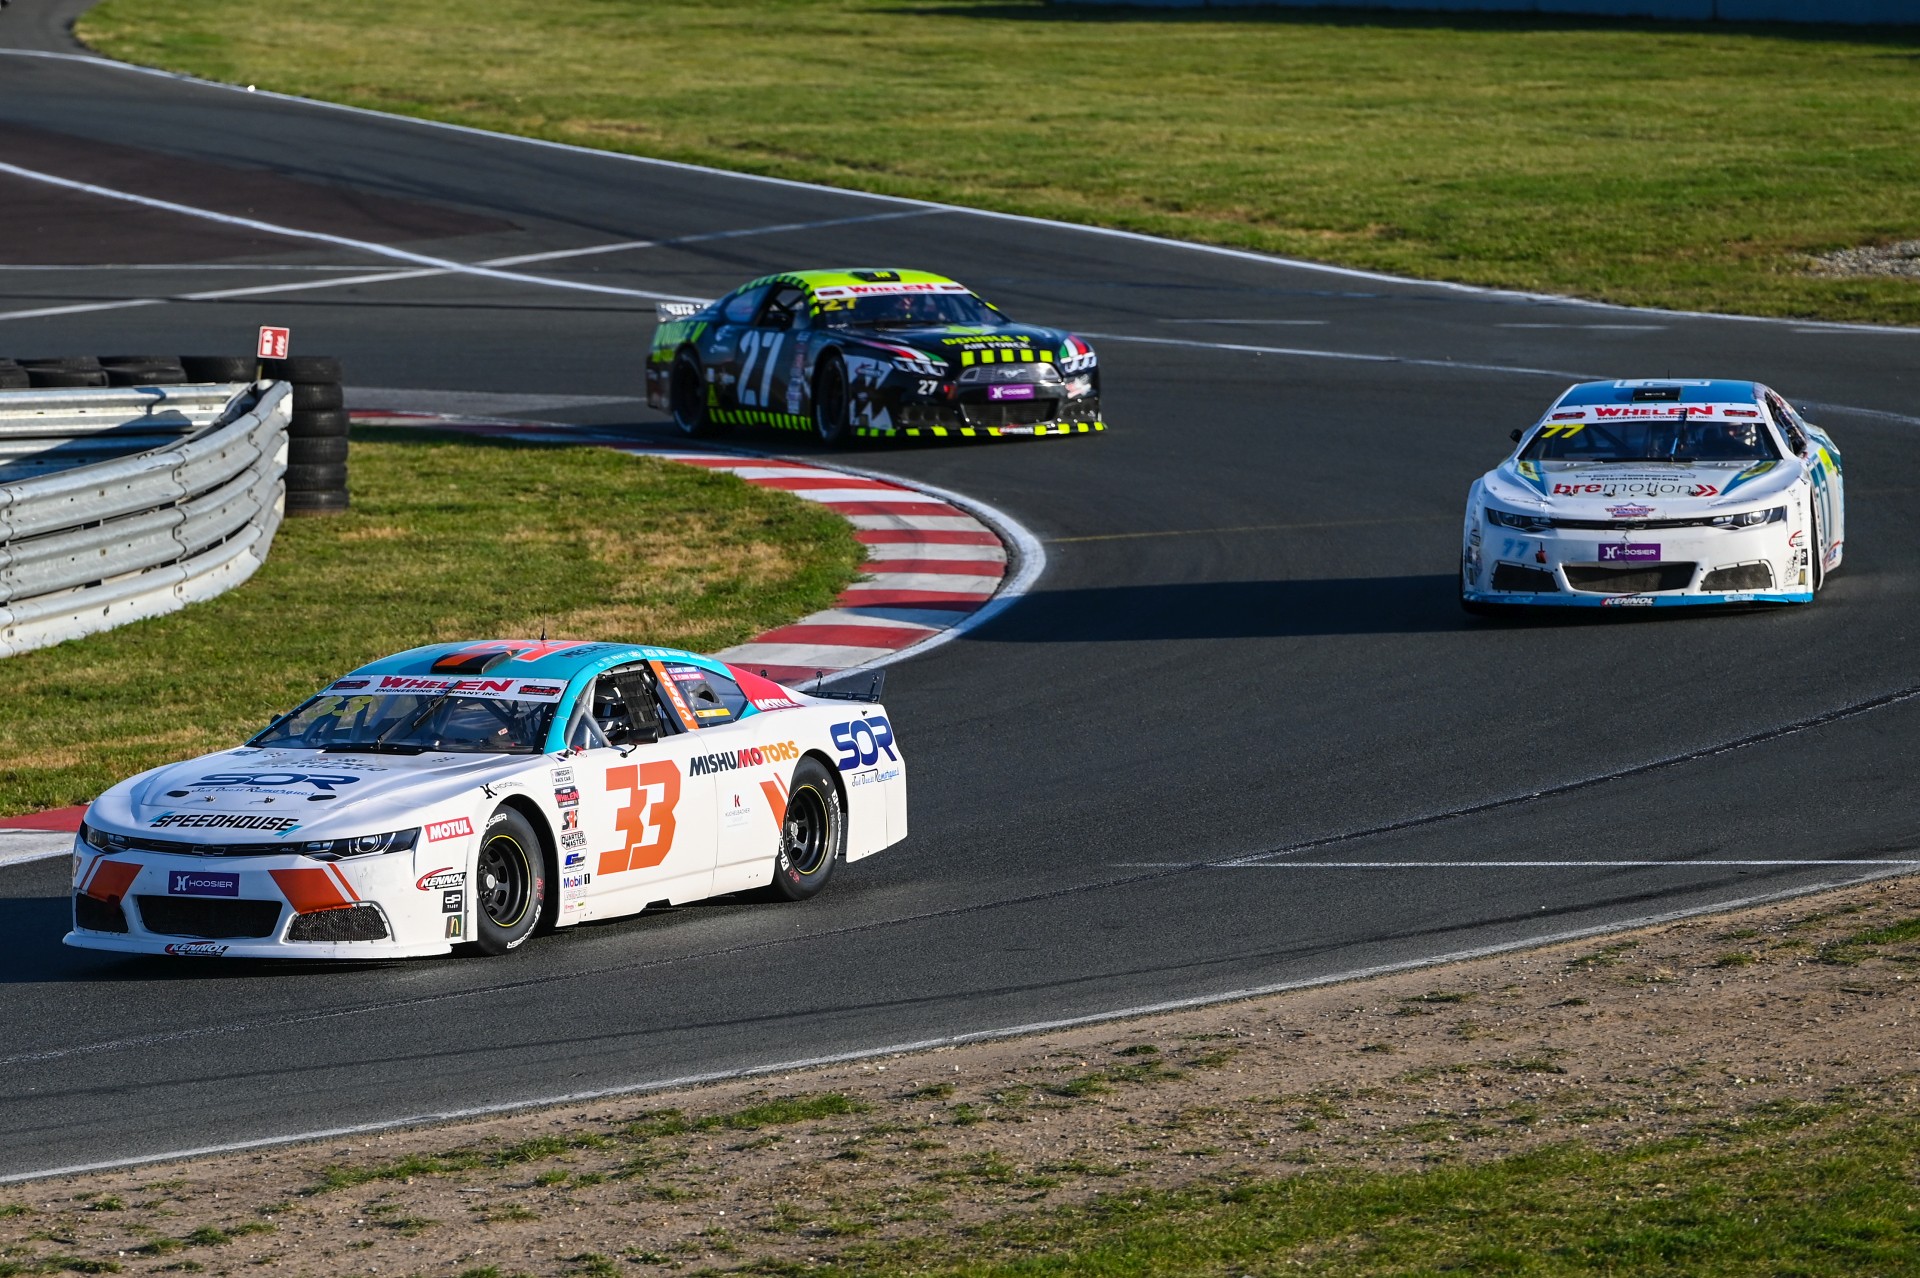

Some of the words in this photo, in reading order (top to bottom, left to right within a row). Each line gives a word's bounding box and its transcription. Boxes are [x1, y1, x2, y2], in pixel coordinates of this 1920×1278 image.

[848, 284, 934, 293] WHELEN
[821, 298, 857, 311] 27
[737, 330, 785, 407] 27
[917, 380, 939, 396] 27
[1595, 406, 1713, 417] WHELEN
[1541, 424, 1585, 438] 77
[1553, 481, 1692, 495] bremotion
[1503, 538, 1531, 559] 77
[379, 676, 515, 692] WHELEN
[755, 698, 793, 711] MOTUL
[830, 716, 897, 771] SOR
[187, 773, 361, 790] SOR
[151, 814, 299, 831] SPEEDHOUSE
[597, 759, 681, 876] 33
[430, 820, 470, 840] MOTUL
[189, 880, 233, 888] HOOSIER
[421, 873, 464, 887] KENNOL
[564, 875, 583, 889] Mobil
[170, 943, 226, 953] KENNOL
